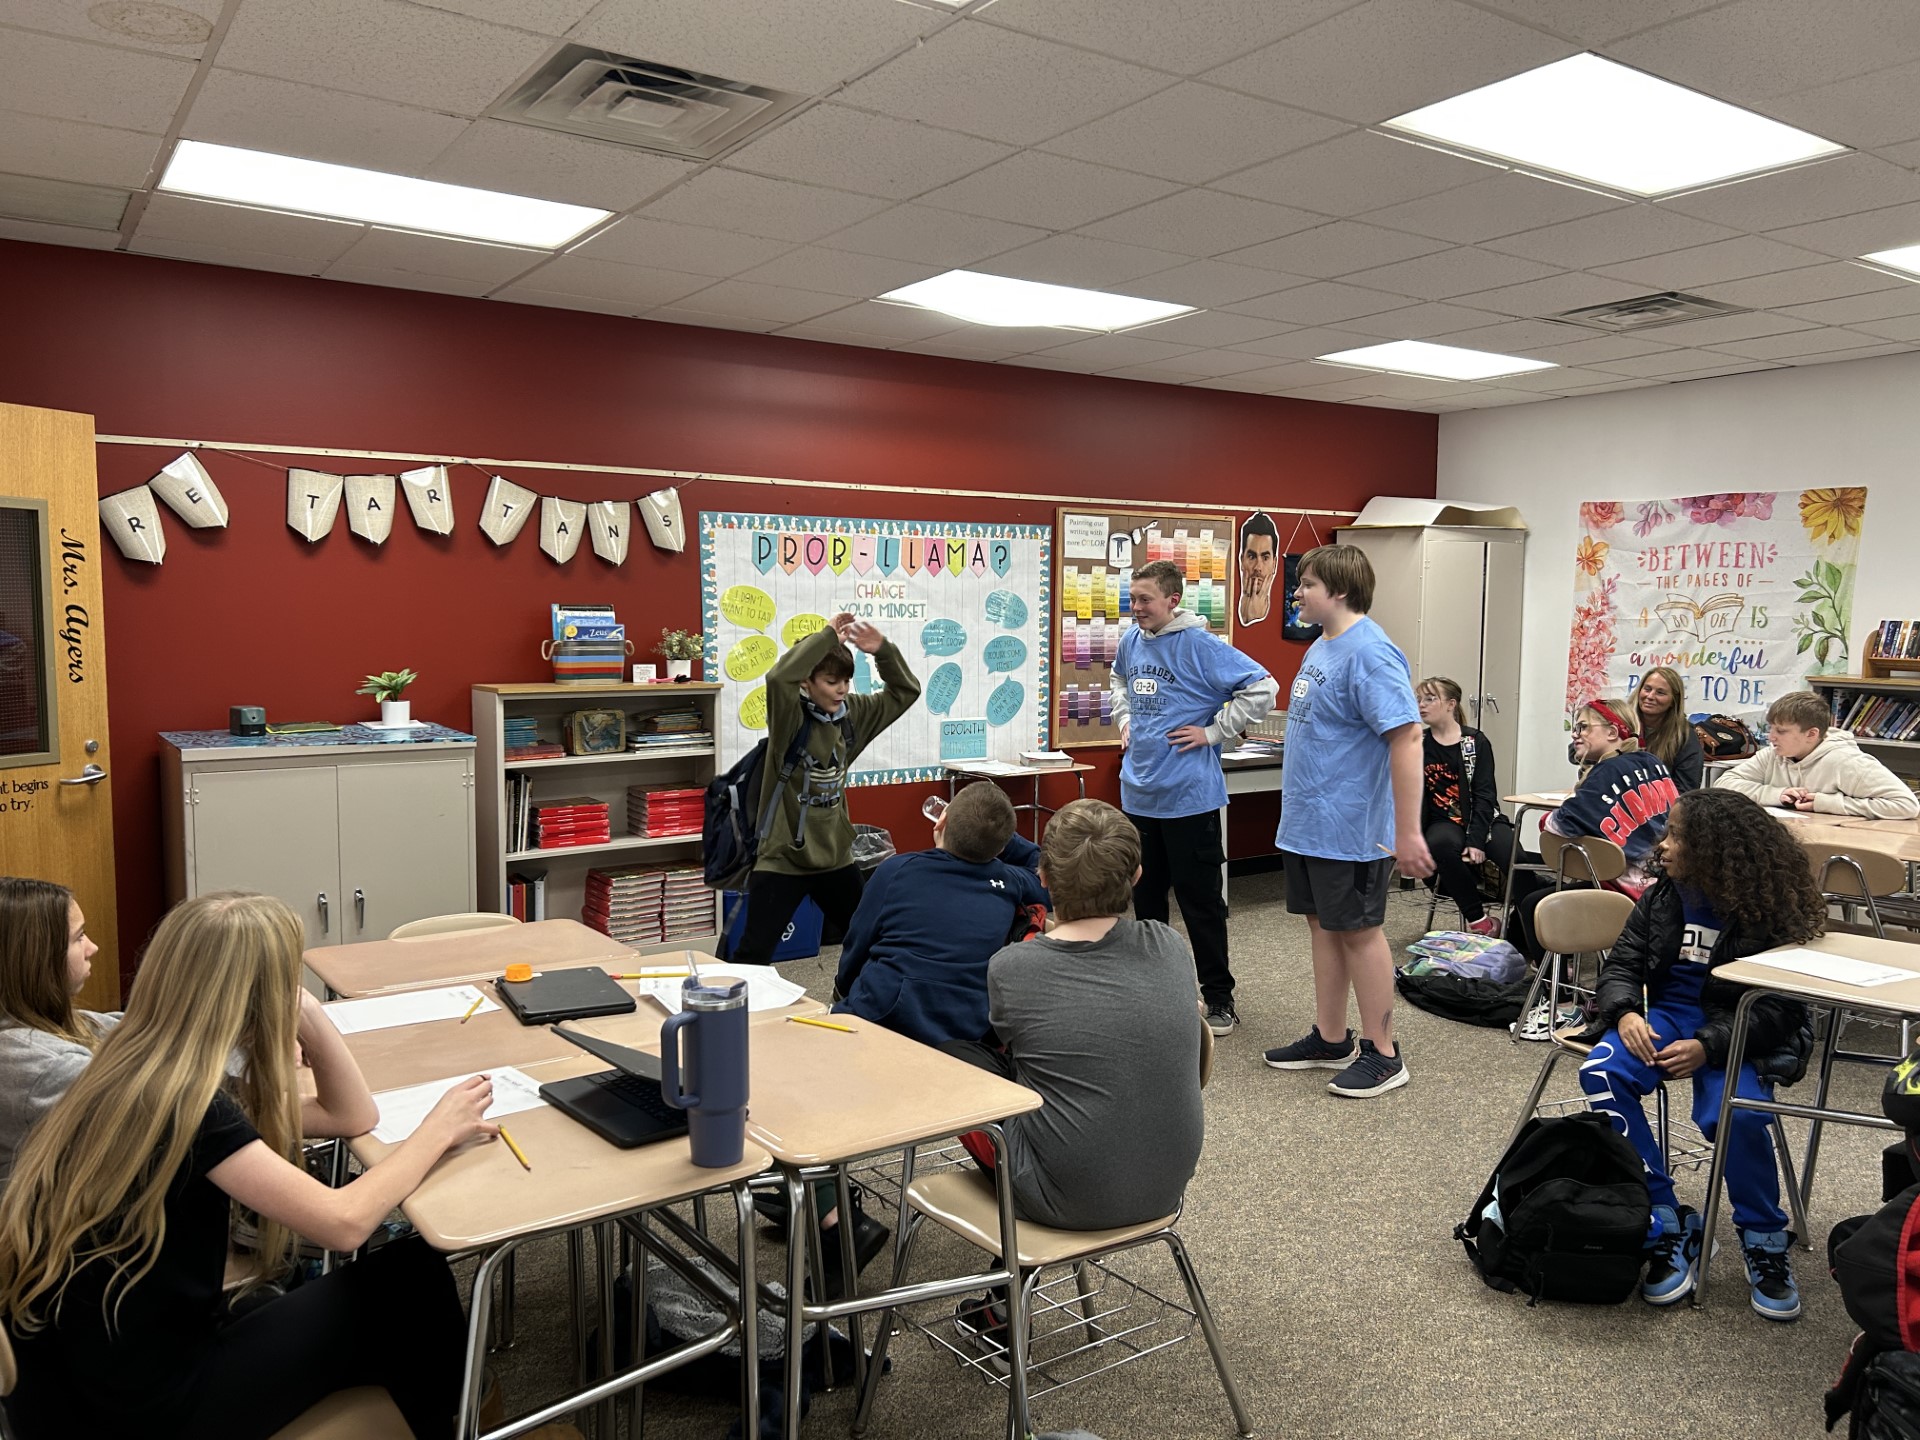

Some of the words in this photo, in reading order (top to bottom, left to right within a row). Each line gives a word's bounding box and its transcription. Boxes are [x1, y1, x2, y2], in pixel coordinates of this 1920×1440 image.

[1069, 519, 1092, 527] Painting
[758, 536, 1008, 570] PROB-LLAMA?
[1648, 542, 1766, 571] BETWEEN
[60, 528, 86, 595] Mrs.
[1657, 575, 1679, 589] THE
[1687, 573, 1728, 587] PAGES
[1737, 573, 1753, 587] OF
[856, 583, 905, 599] CHANGE
[741, 592, 764, 607] DON'T
[839, 603, 873, 618] YOUR
[879, 603, 926, 619] MINDSET
[1638, 607, 1649, 628] A
[1750, 606, 1768, 629] IS
[590, 629, 608, 637] Zeus
[798, 619, 826, 633] CAN'T
[60, 604, 89, 684] Ayers
[1630, 652, 1646, 667] a
[1650, 645, 1769, 674] wonderful
[1142, 664, 1176, 685] LEADER
[1135, 682, 1155, 692] 23-24
[1701, 675, 1728, 702] TO
[943, 723, 985, 736] GROWTH
[944, 740, 986, 755] MINDSET
[12, 779, 49, 795] begins
[10, 798, 34, 812] try.
